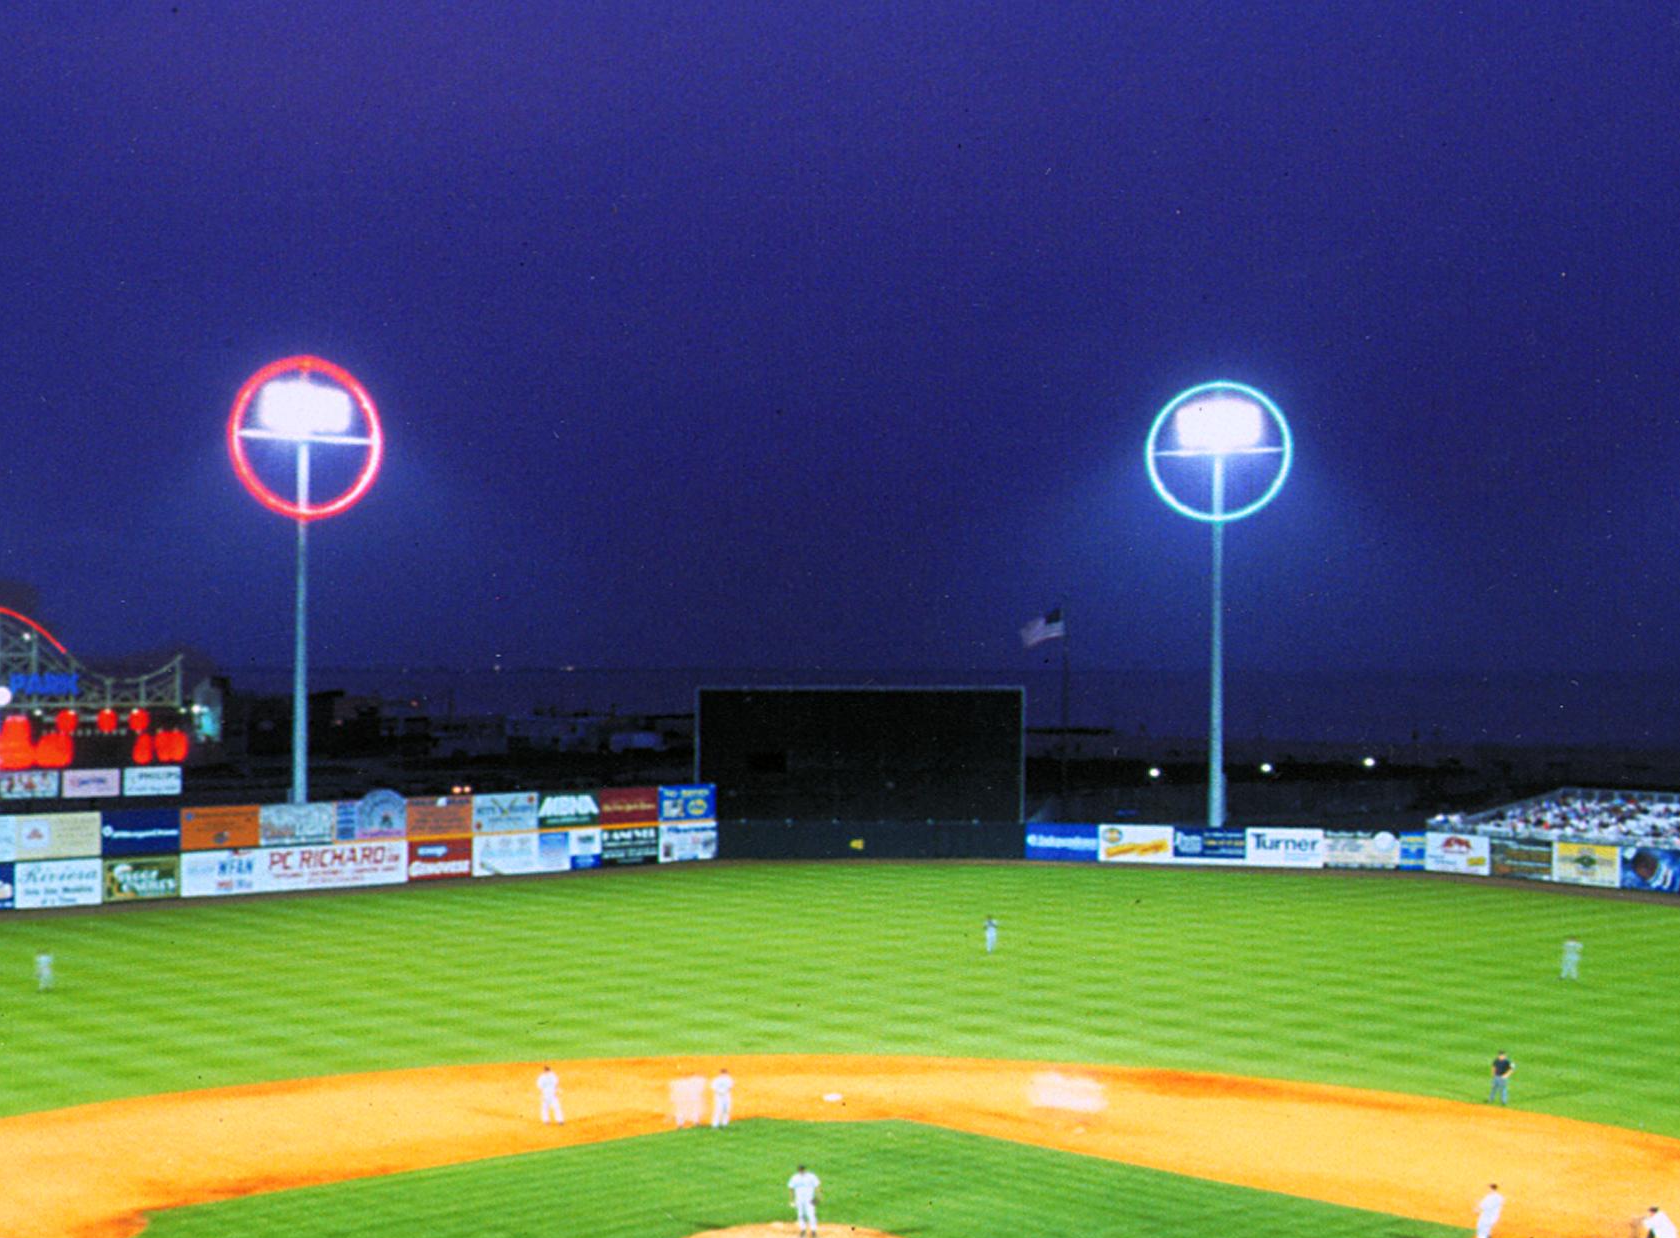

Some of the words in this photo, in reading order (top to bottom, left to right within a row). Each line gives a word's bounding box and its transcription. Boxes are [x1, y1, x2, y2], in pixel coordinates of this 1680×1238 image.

[9, 673, 79, 695] PARK
[1251, 832, 1318, 851] Turner
[270, 851, 293, 870] PC
[299, 846, 385, 869] RICHARD
